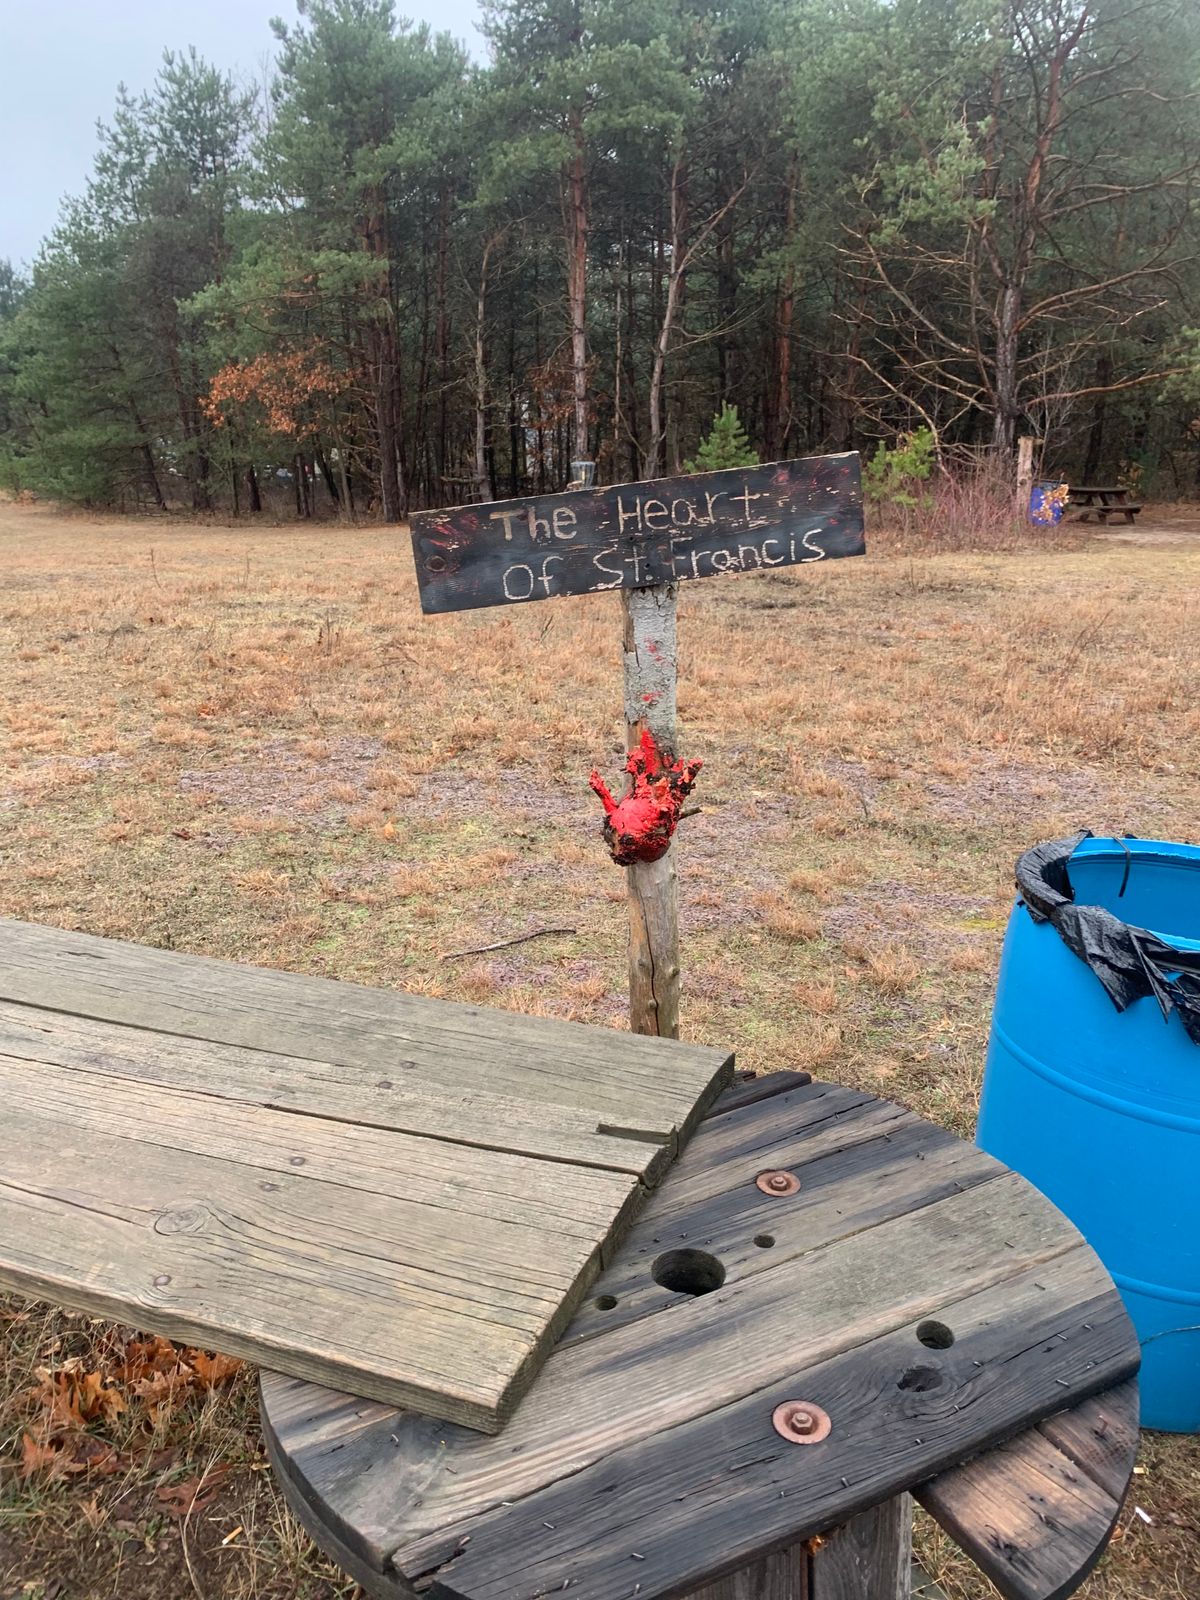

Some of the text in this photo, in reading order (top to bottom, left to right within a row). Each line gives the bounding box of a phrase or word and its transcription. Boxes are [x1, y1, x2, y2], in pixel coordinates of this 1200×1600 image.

[490, 485, 764, 541] The Heart
[593, 545, 653, 589] St.
[668, 528, 826, 579] Francis
